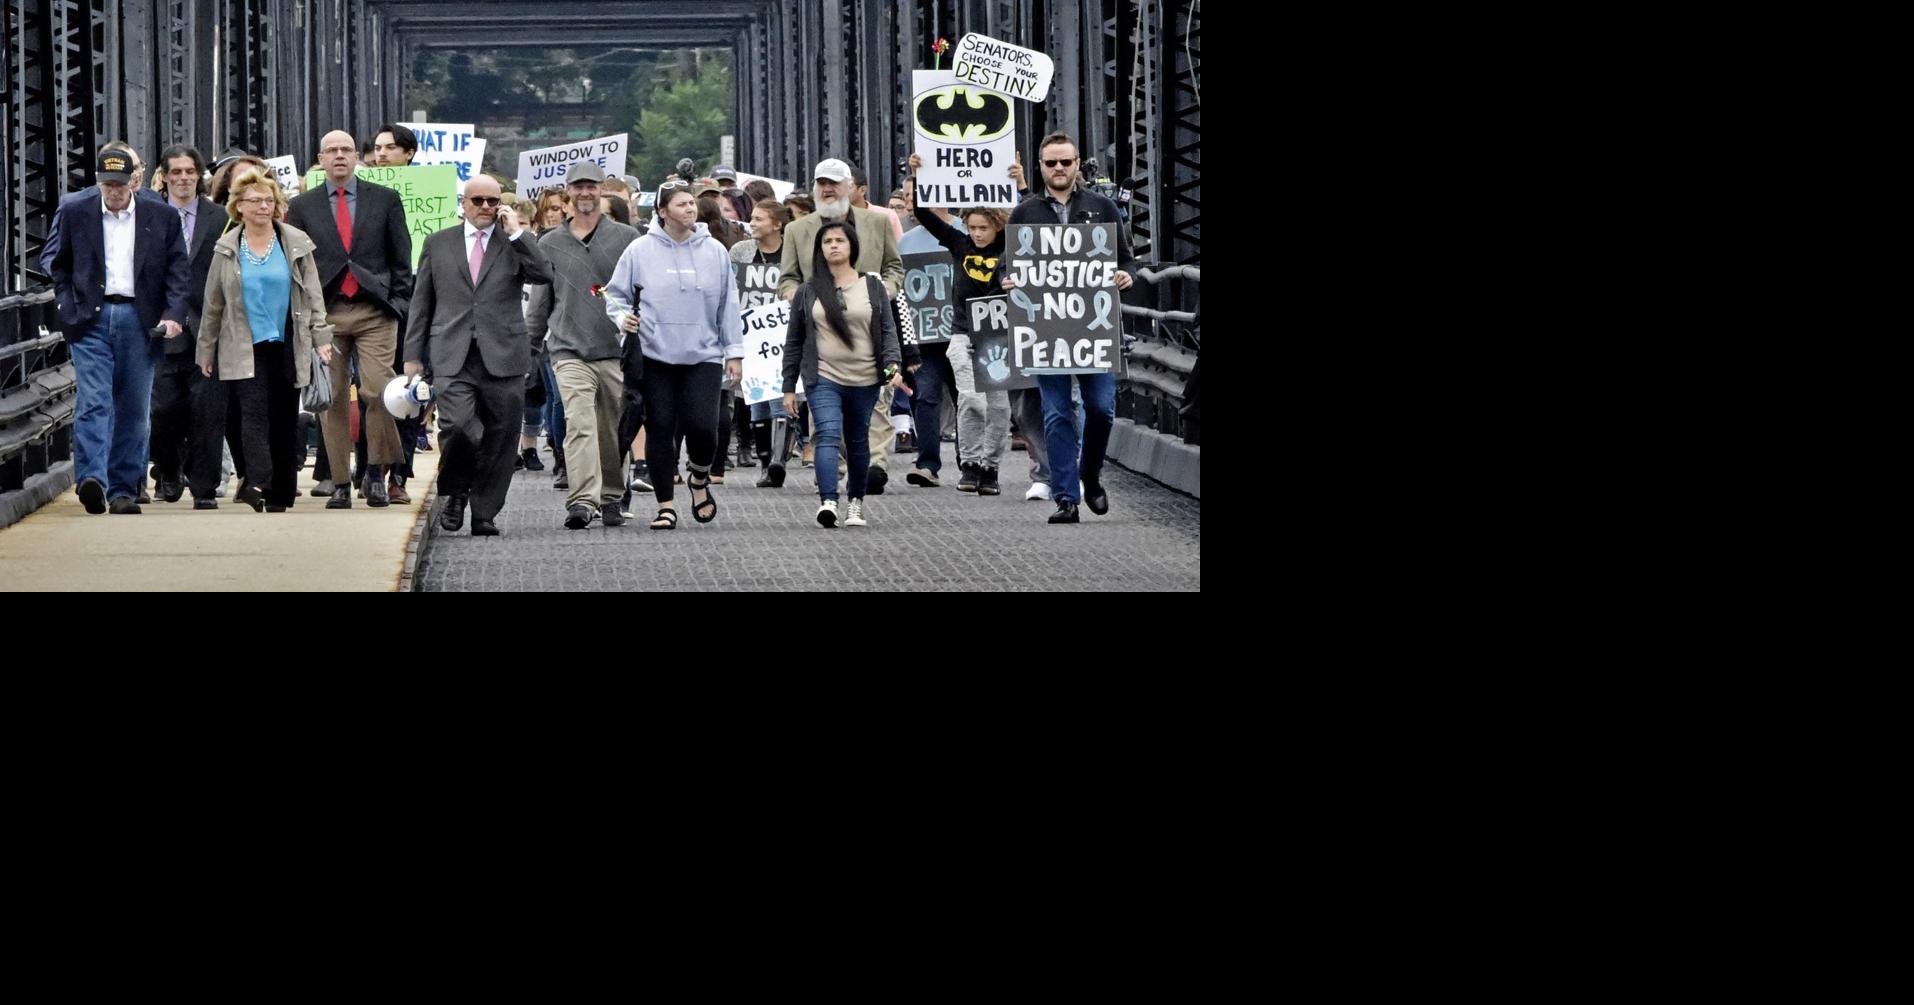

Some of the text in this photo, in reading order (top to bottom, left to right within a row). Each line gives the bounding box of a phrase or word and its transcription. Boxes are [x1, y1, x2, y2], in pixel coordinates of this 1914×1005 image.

[962, 34, 1033, 68] SENATORS,
[961, 52, 1039, 80] CHOOSE YOUR
[453, 133, 472, 152] IF
[529, 141, 619, 166] WINDOW TO
[533, 156, 607, 180] JUSE
[936, 147, 993, 168] HERO
[358, 168, 403, 181] SAID:
[957, 170, 973, 178] OR
[918, 184, 1012, 203] VILLAIN
[1039, 226, 1082, 255] NO
[745, 264, 781, 289] NO
[904, 263, 954, 302] OT
[1010, 260, 1118, 288] JUSTICE
[1043, 291, 1085, 320] NO
[1014, 326, 1113, 368] PEACE
